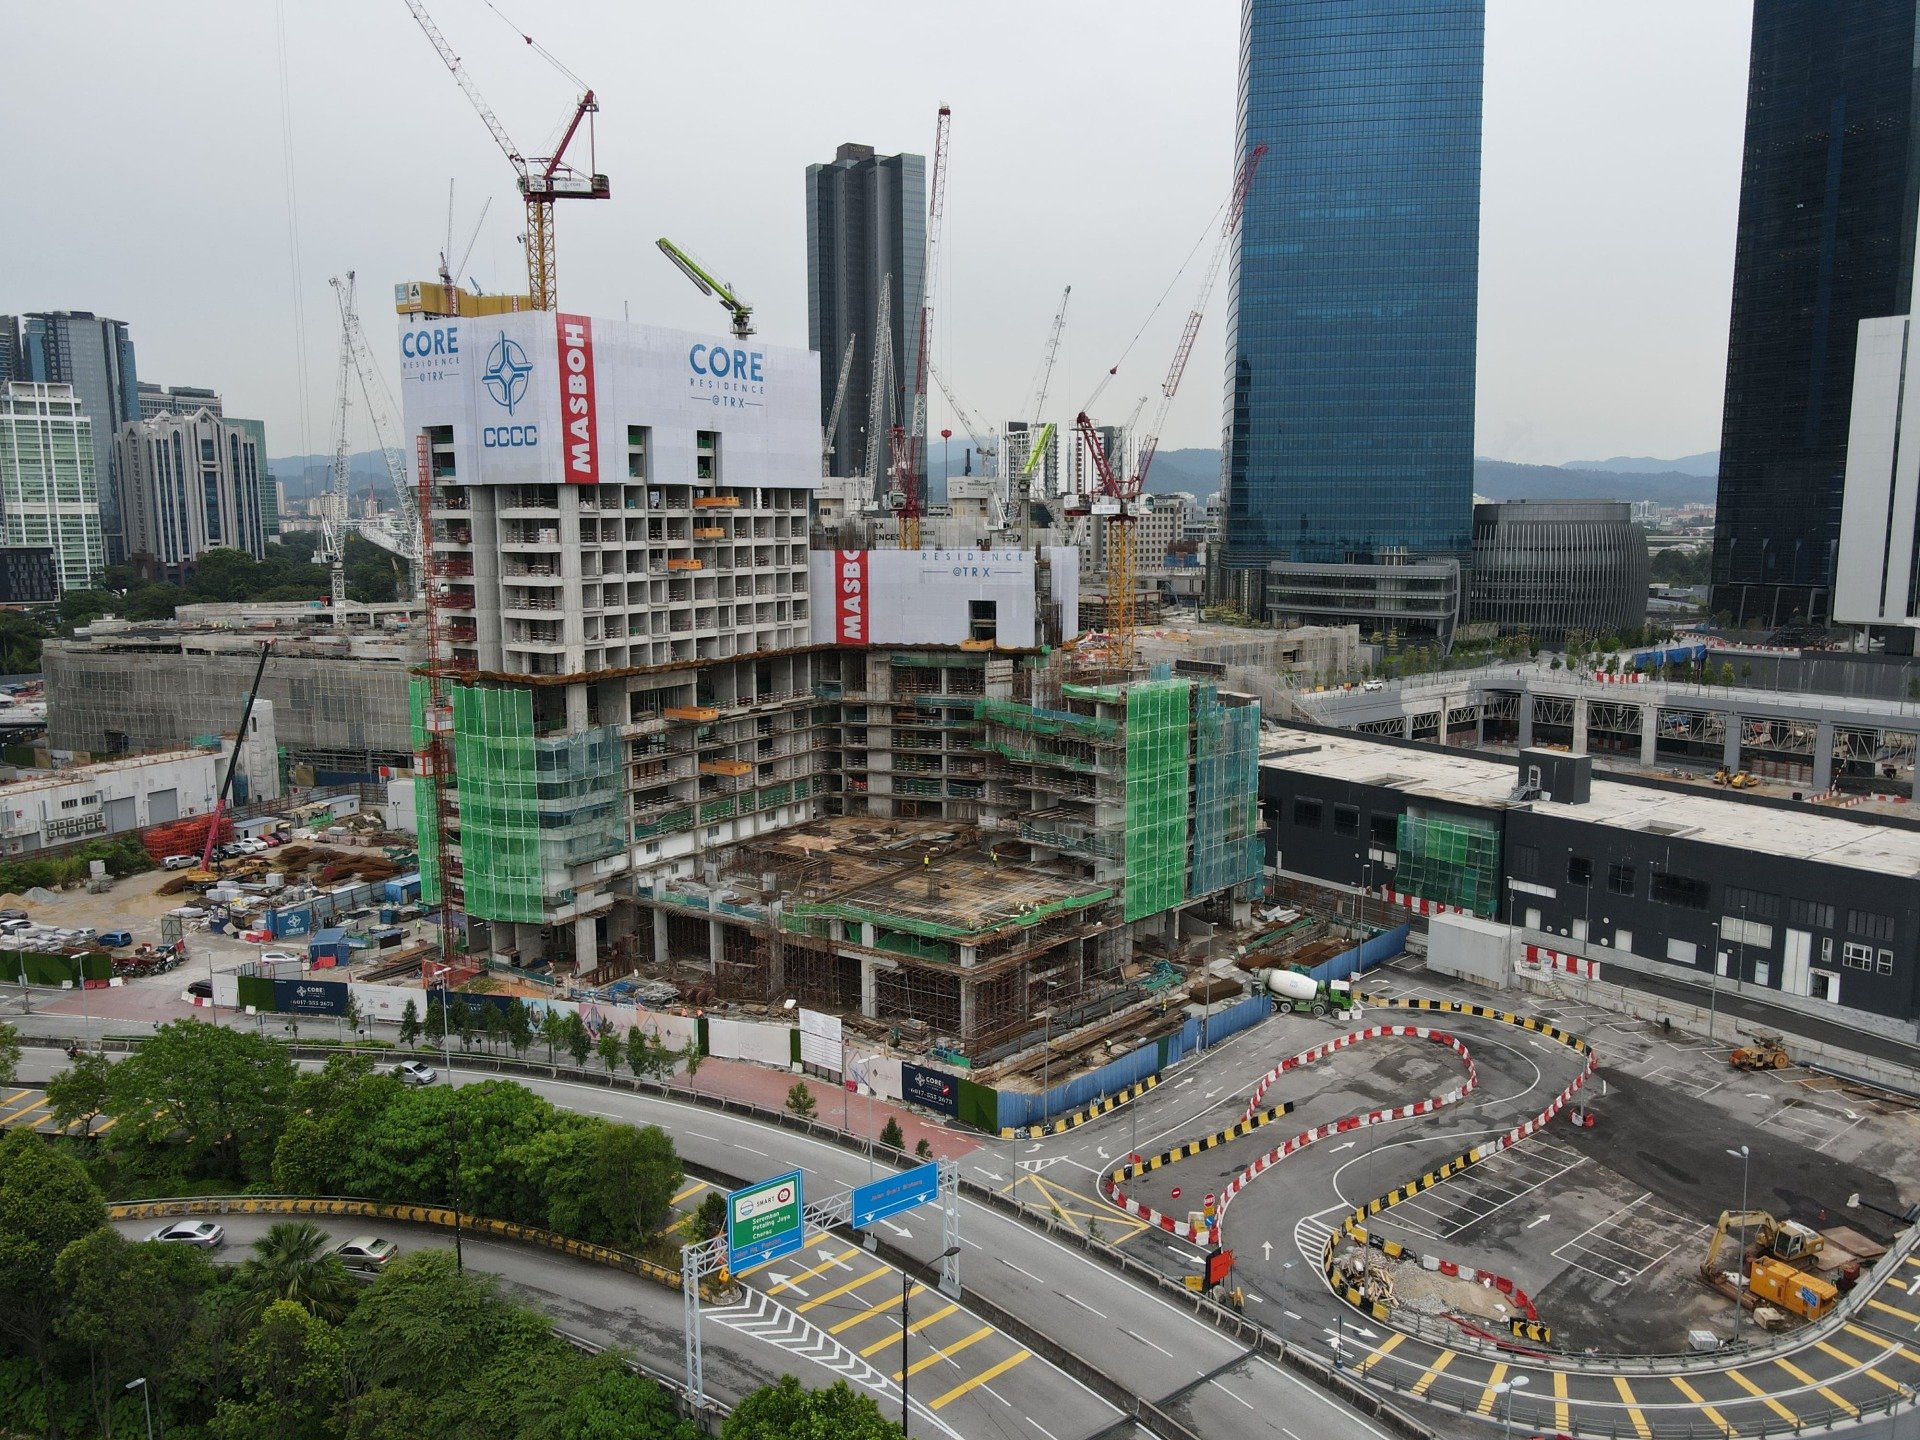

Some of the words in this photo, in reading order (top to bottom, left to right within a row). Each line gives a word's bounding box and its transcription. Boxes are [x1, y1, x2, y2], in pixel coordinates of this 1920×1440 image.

[402, 327, 459, 358] CORE
[403, 356, 460, 369] RESIDENCE
[689, 343, 764, 382] CORE
[420, 371, 443, 381] @TRX
[690, 378, 764, 394] RESIDENCE
[564, 323, 592, 474] MASBOH
[712, 395, 745, 408] @TRX
[483, 425, 538, 448] CCCC
[922, 552, 1023, 562] RESIDENCE
[953, 567, 990, 577] @TRX
[756, 1196, 775, 1207] SMART
